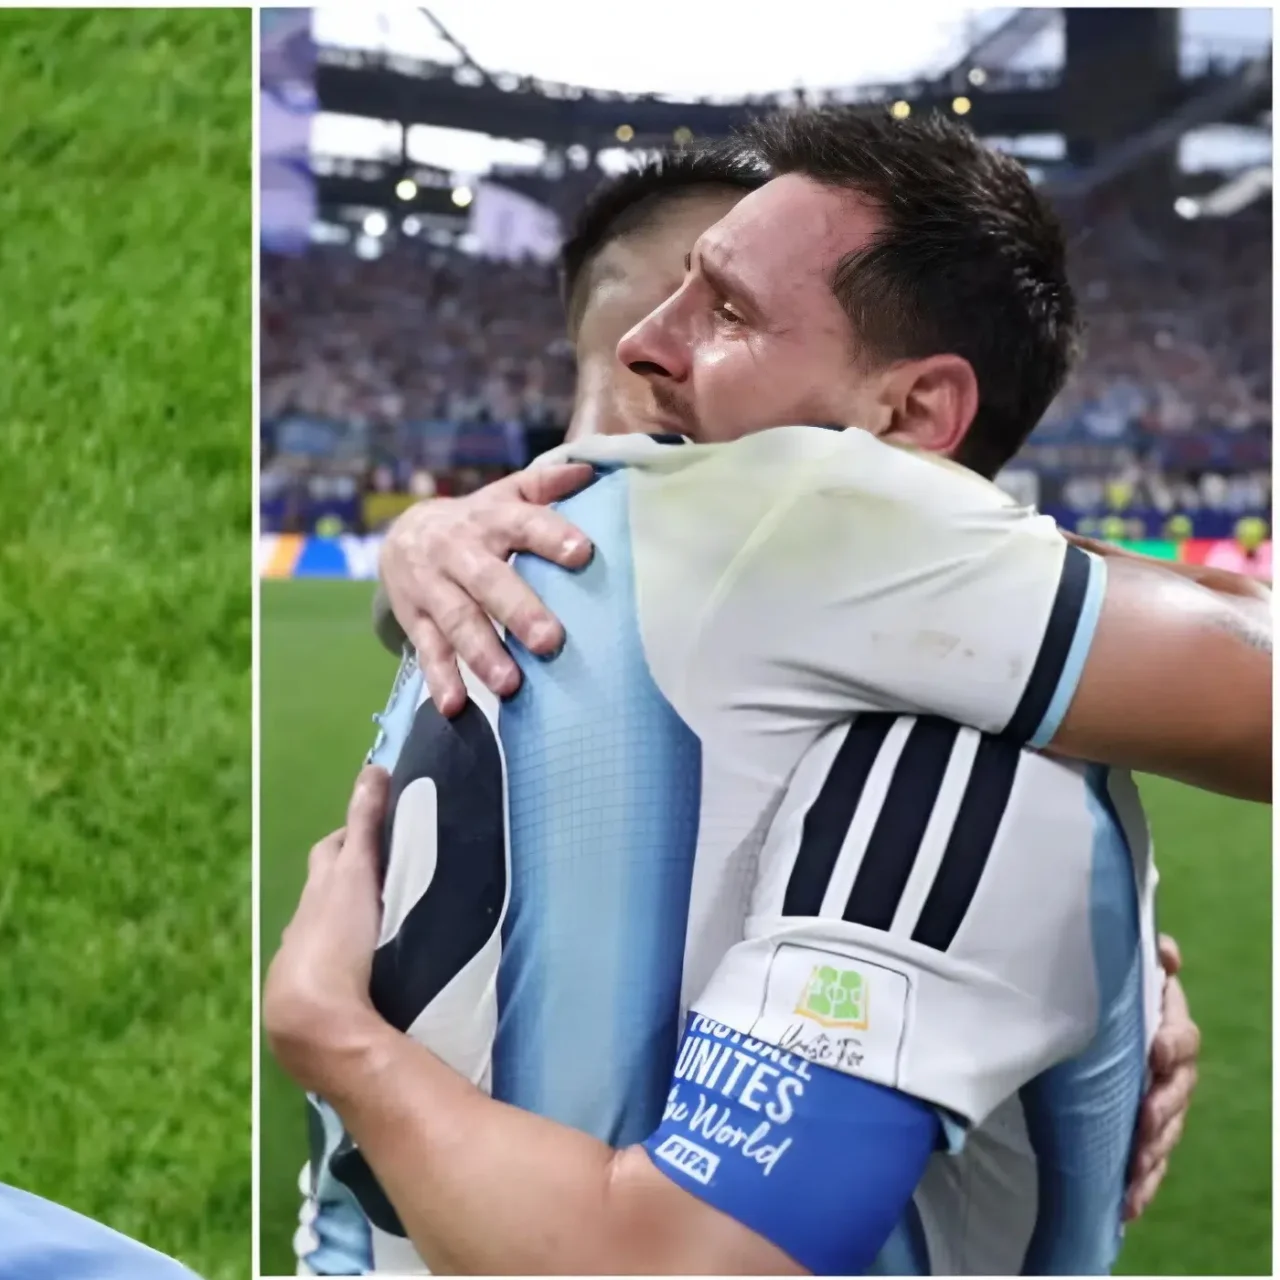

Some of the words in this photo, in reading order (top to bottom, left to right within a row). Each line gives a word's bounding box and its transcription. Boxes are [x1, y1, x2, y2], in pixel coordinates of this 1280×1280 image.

[674, 1036, 804, 1125] UNITES
[660, 1138, 714, 1180] FIFA
[689, 1094, 793, 1177] World
